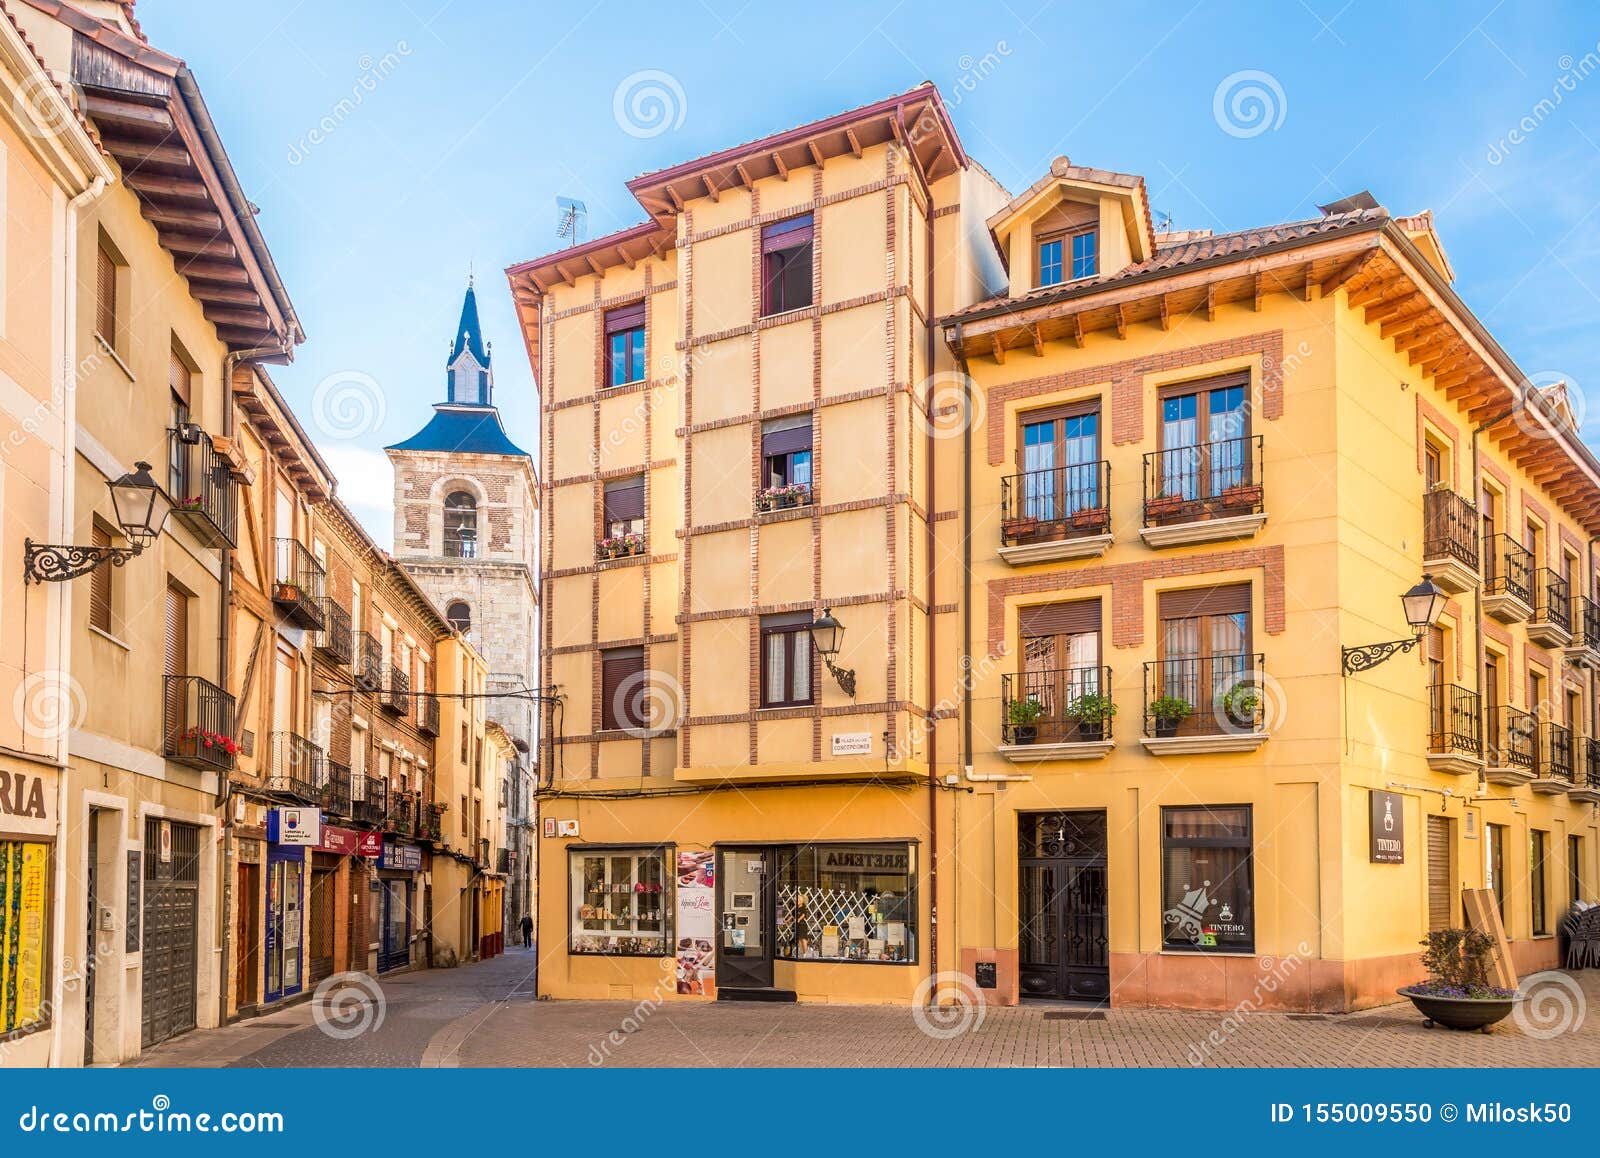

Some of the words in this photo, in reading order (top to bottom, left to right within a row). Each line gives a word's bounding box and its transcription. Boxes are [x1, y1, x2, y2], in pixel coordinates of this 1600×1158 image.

[103, 772, 109, 788] 1
[1058, 829, 1065, 841] 1
[1376, 838, 1401, 852] TINTERO
[1208, 923, 1244, 932] TINTERO
